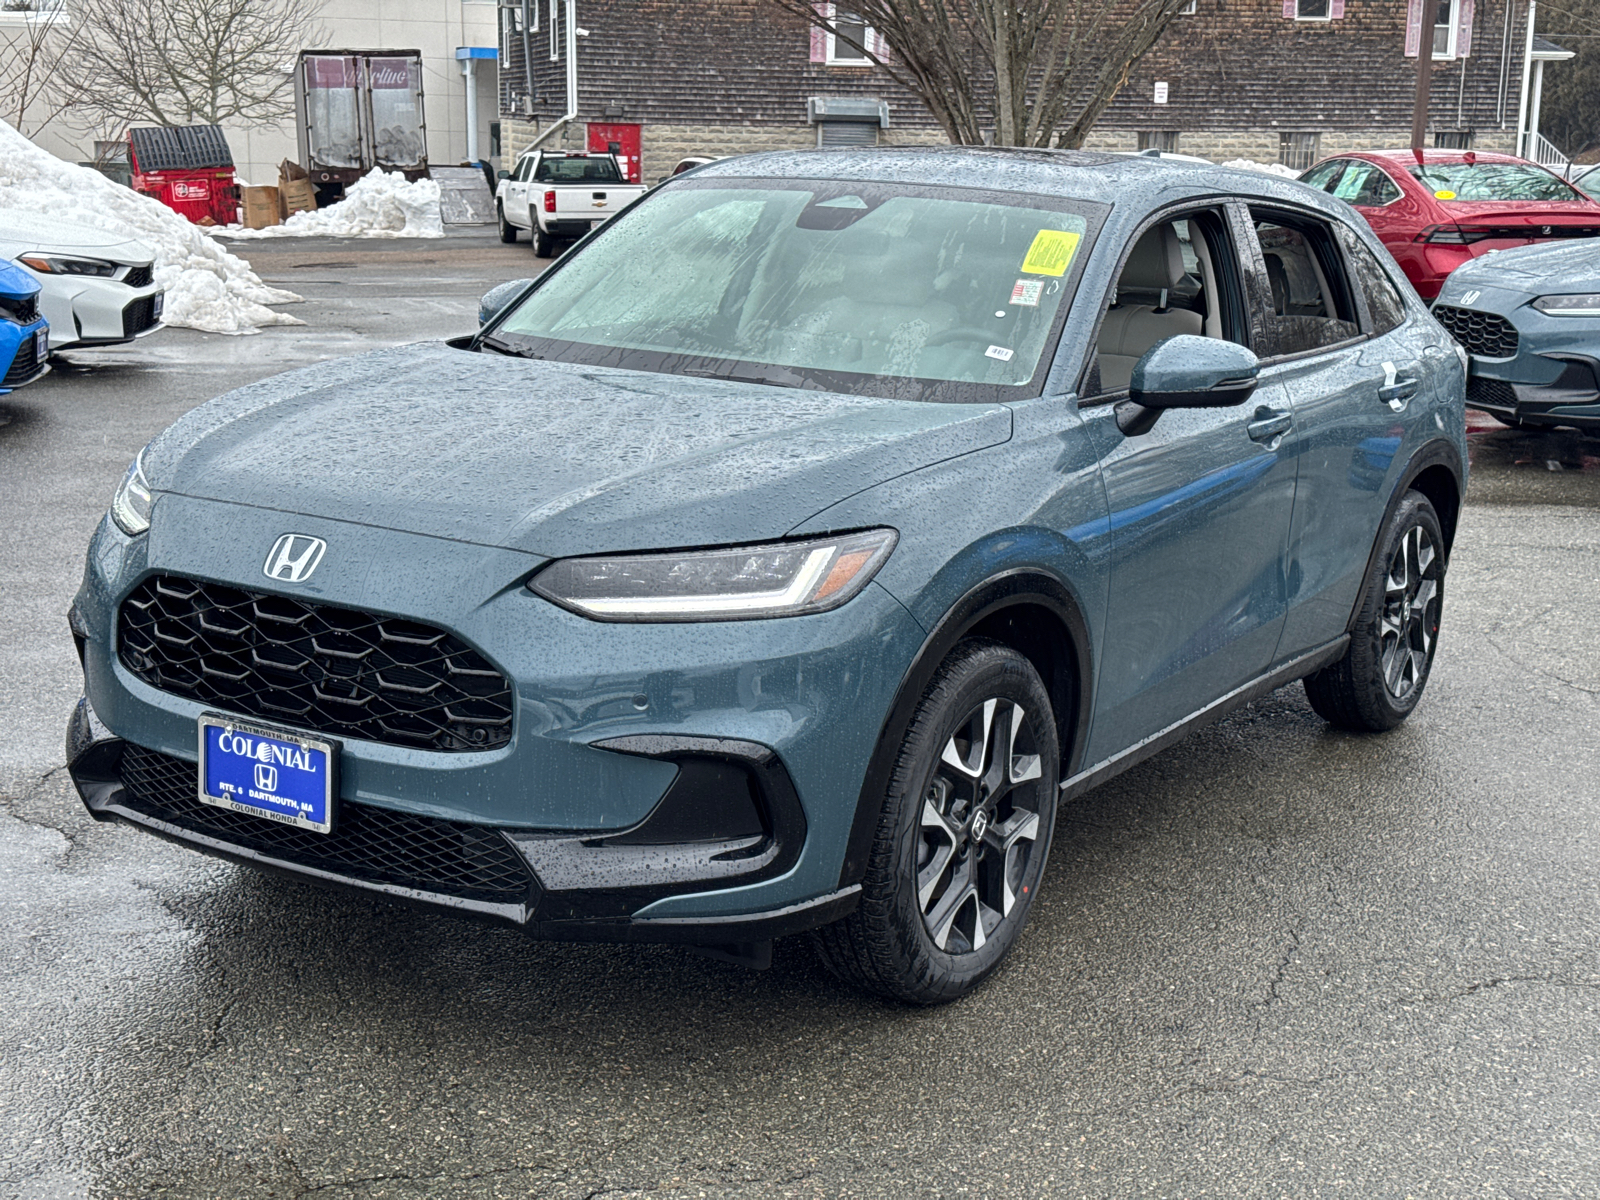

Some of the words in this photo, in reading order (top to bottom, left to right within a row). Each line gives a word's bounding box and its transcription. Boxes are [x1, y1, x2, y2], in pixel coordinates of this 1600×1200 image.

[286, 735, 300, 744] MA
[218, 733, 316, 773] COLONIAL
[219, 782, 236, 793] RTE.
[237, 786, 243, 795] 6
[248, 789, 300, 810] DARTMOUTH,
[300, 802, 314, 813] MA
[230, 802, 268, 818] COLONIAL
[269, 812, 298, 825] HONDA
